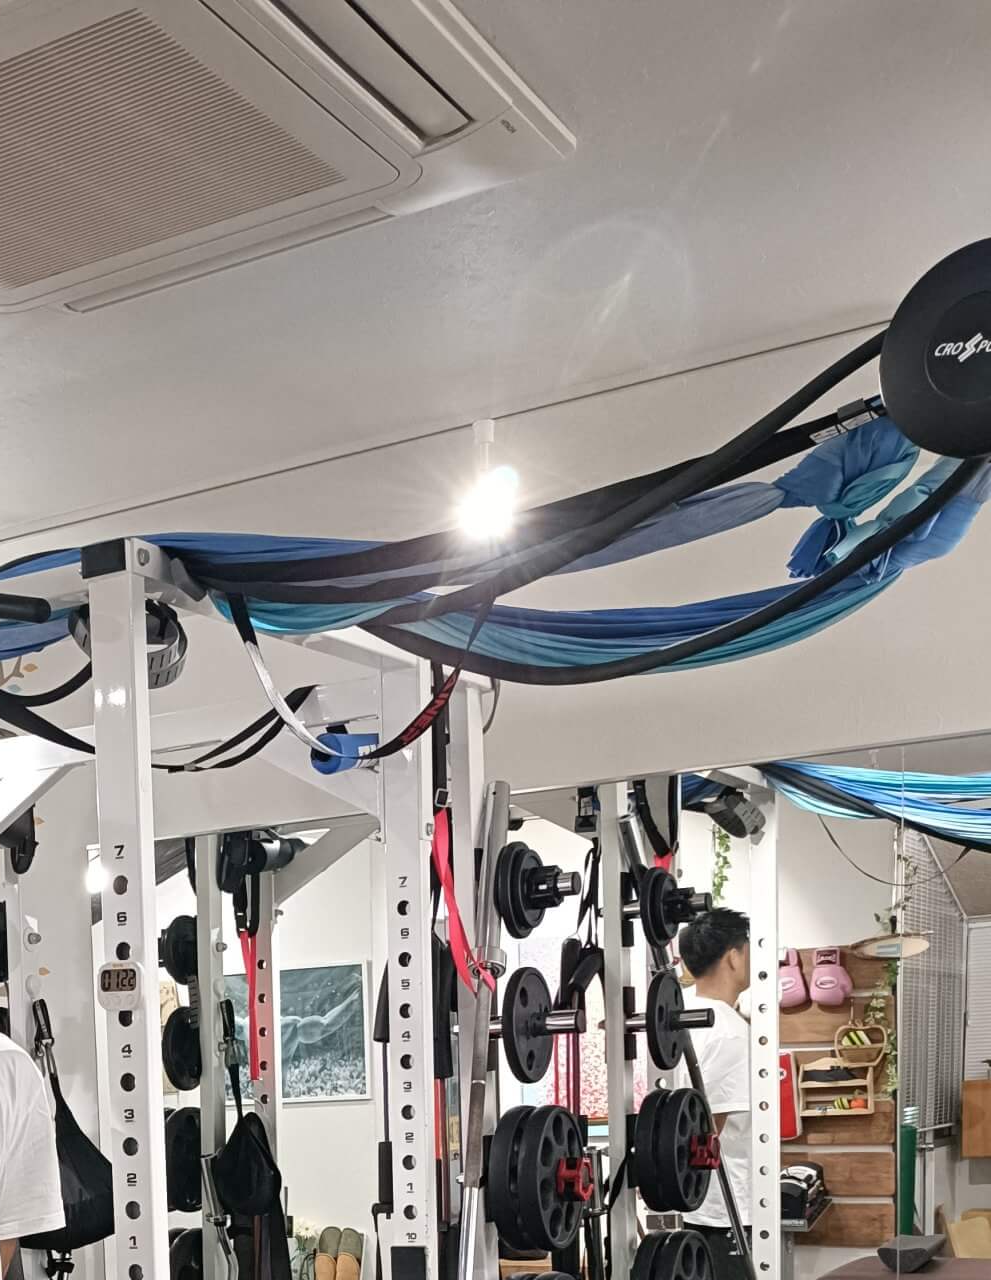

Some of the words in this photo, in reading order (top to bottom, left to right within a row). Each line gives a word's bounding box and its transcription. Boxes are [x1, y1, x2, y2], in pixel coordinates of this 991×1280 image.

[115, 845, 124, 859] 7
[399, 876, 407, 887] 7
[117, 912, 127, 925] 6
[401, 928, 409, 939] 6
[401, 979, 410, 990] 5
[402, 1031, 410, 1041] 4
[122, 1044, 132, 1058] 4
[404, 1082, 412, 1092] 3
[124, 1109, 134, 1122] 3
[406, 1132, 414, 1143] 2
[127, 1173, 136, 1186] 2
[407, 1183, 413, 1193] 1
[130, 1236, 137, 1249] 1
[406, 1233, 416, 1242] 10
